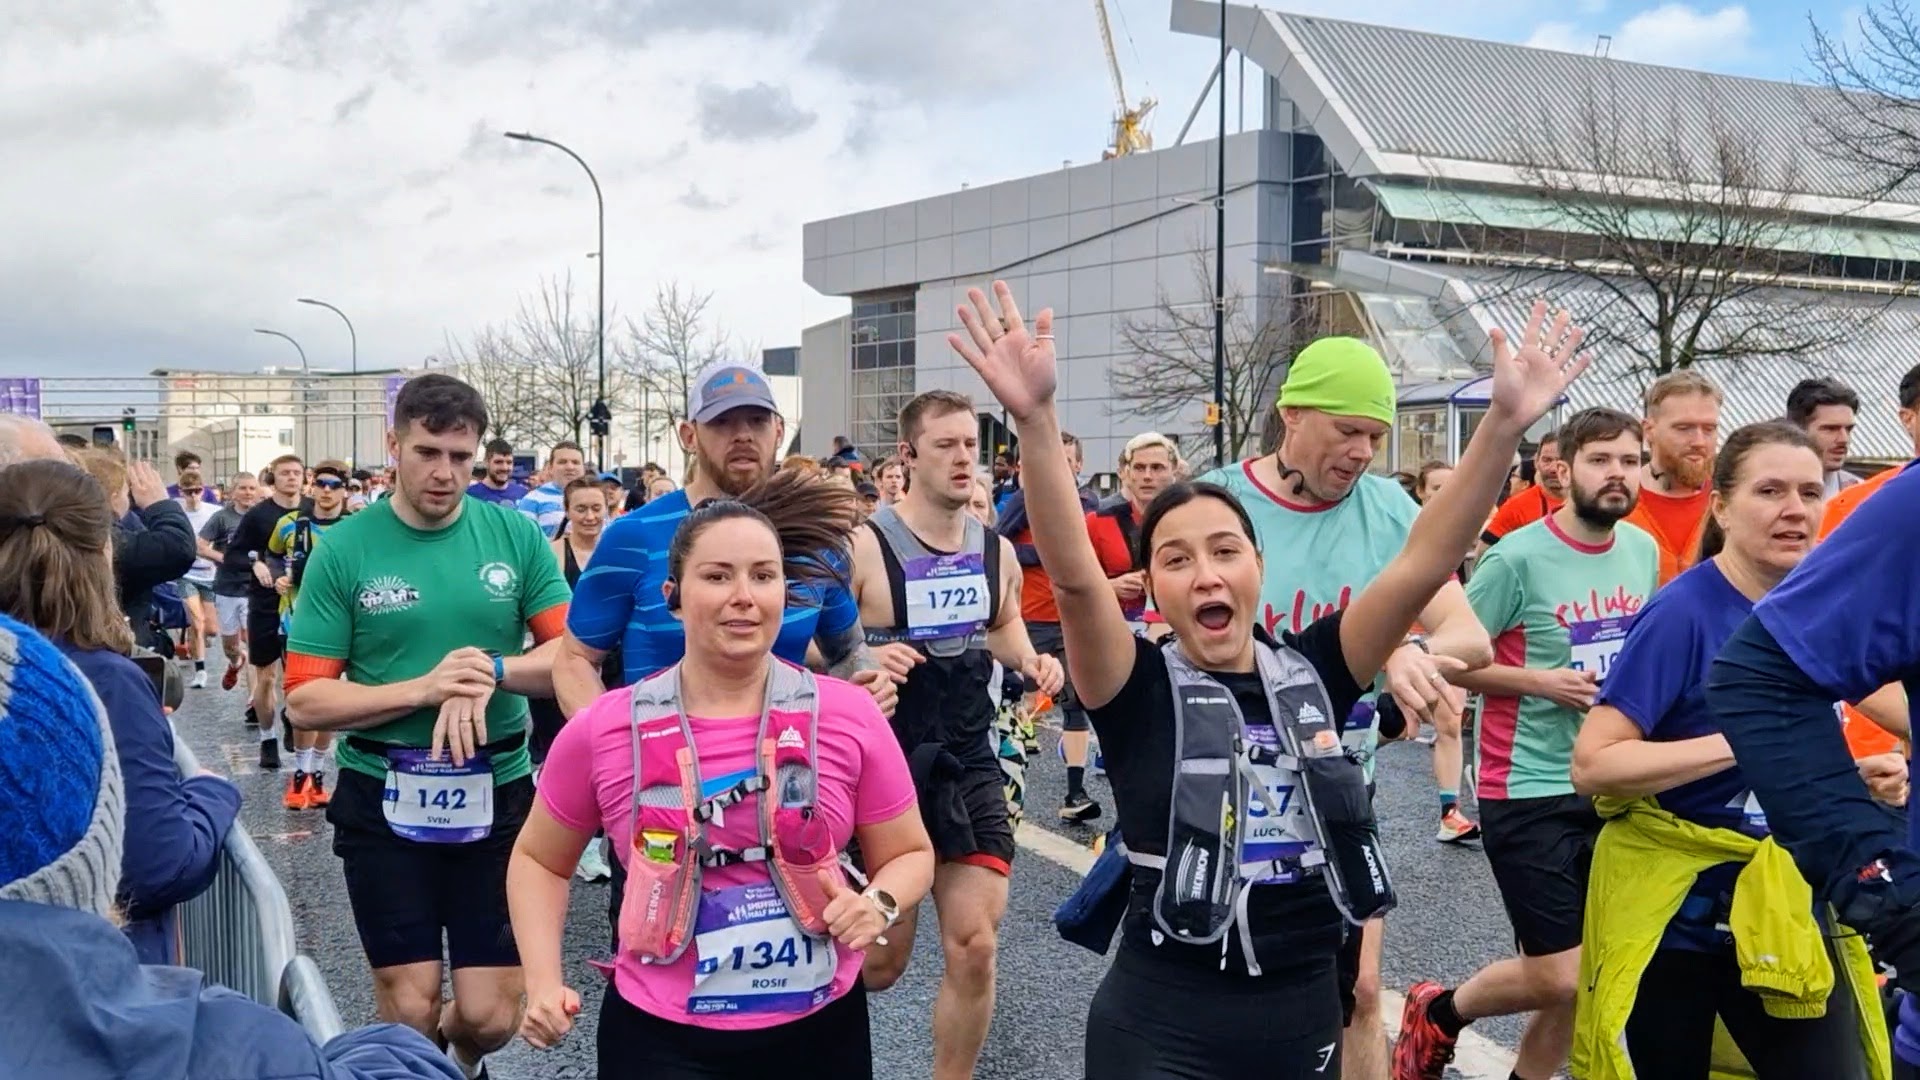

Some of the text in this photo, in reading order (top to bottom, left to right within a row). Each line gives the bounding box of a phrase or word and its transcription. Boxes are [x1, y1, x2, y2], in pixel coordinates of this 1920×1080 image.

[928, 587, 979, 609] 1722
[418, 788, 467, 810] 142
[426, 816, 451, 825] SVEN
[1253, 827, 1286, 839] LUCY
[731, 934, 813, 971] 1341
[751, 977, 789, 990] ROSIE
